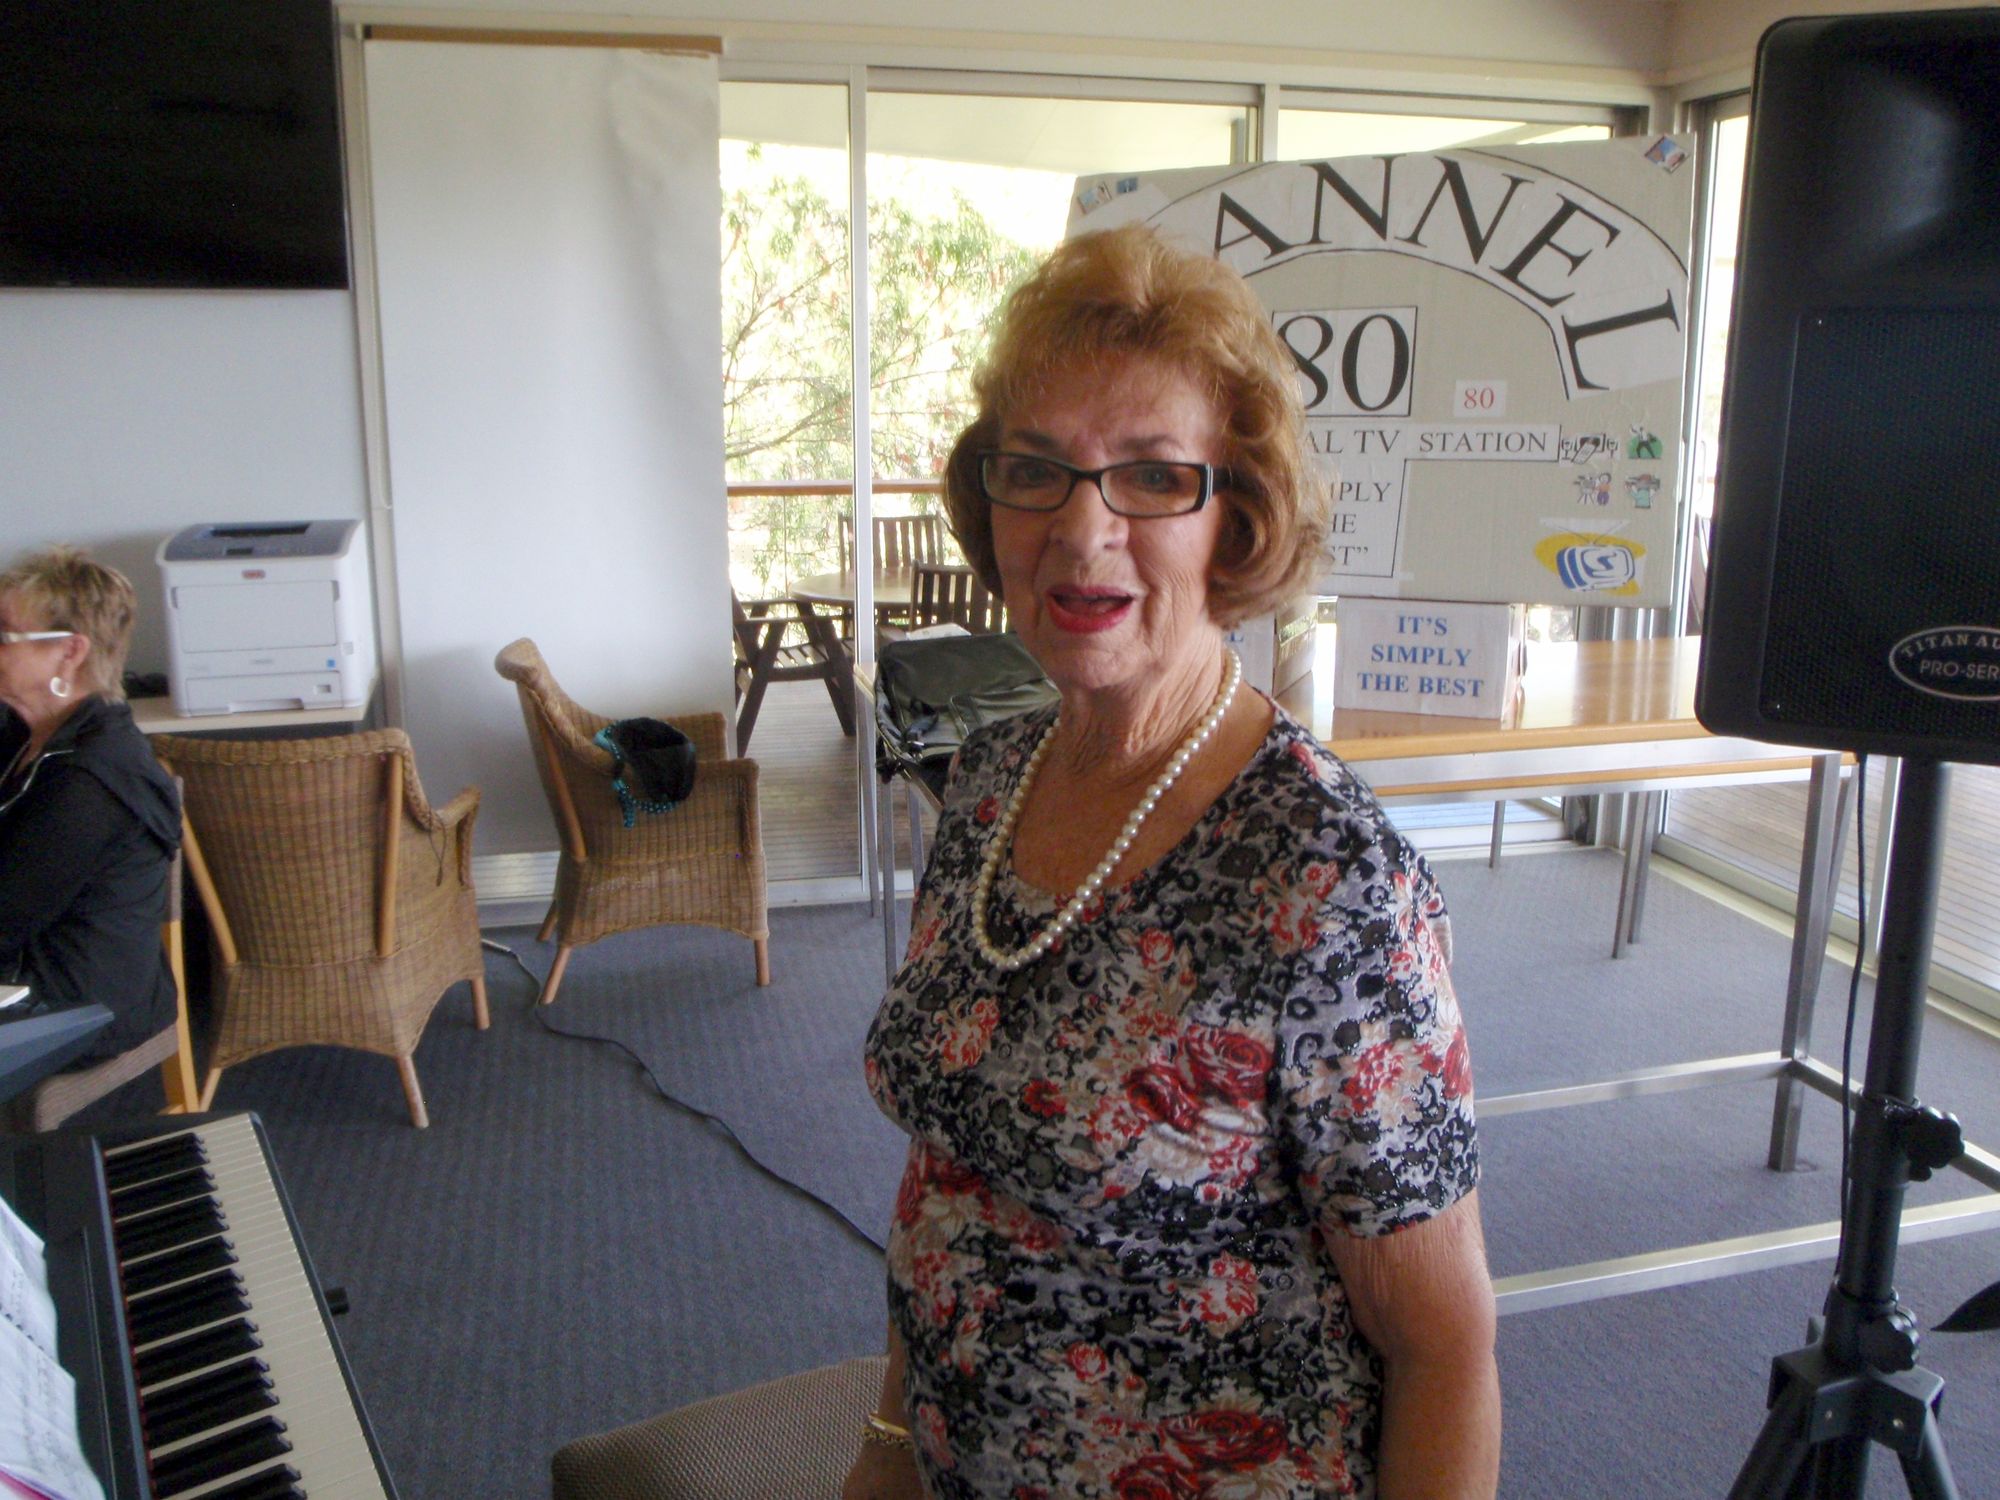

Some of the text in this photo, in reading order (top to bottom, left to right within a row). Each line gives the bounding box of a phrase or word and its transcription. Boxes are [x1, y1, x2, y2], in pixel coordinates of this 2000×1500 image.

[1212, 154, 1681, 392] ANNEL
[1277, 313, 1409, 412] 80
[1463, 387, 1495, 410] 80
[1302, 429, 1547, 454] AL TV STATION
[1330, 481, 1392, 502] PLY
[1370, 643, 1472, 667] SIMPLY
[1901, 633, 2000, 657] TITAN AU
[1920, 659, 2000, 680] PRO-SER
[1357, 672, 1485, 698] THE BEST
